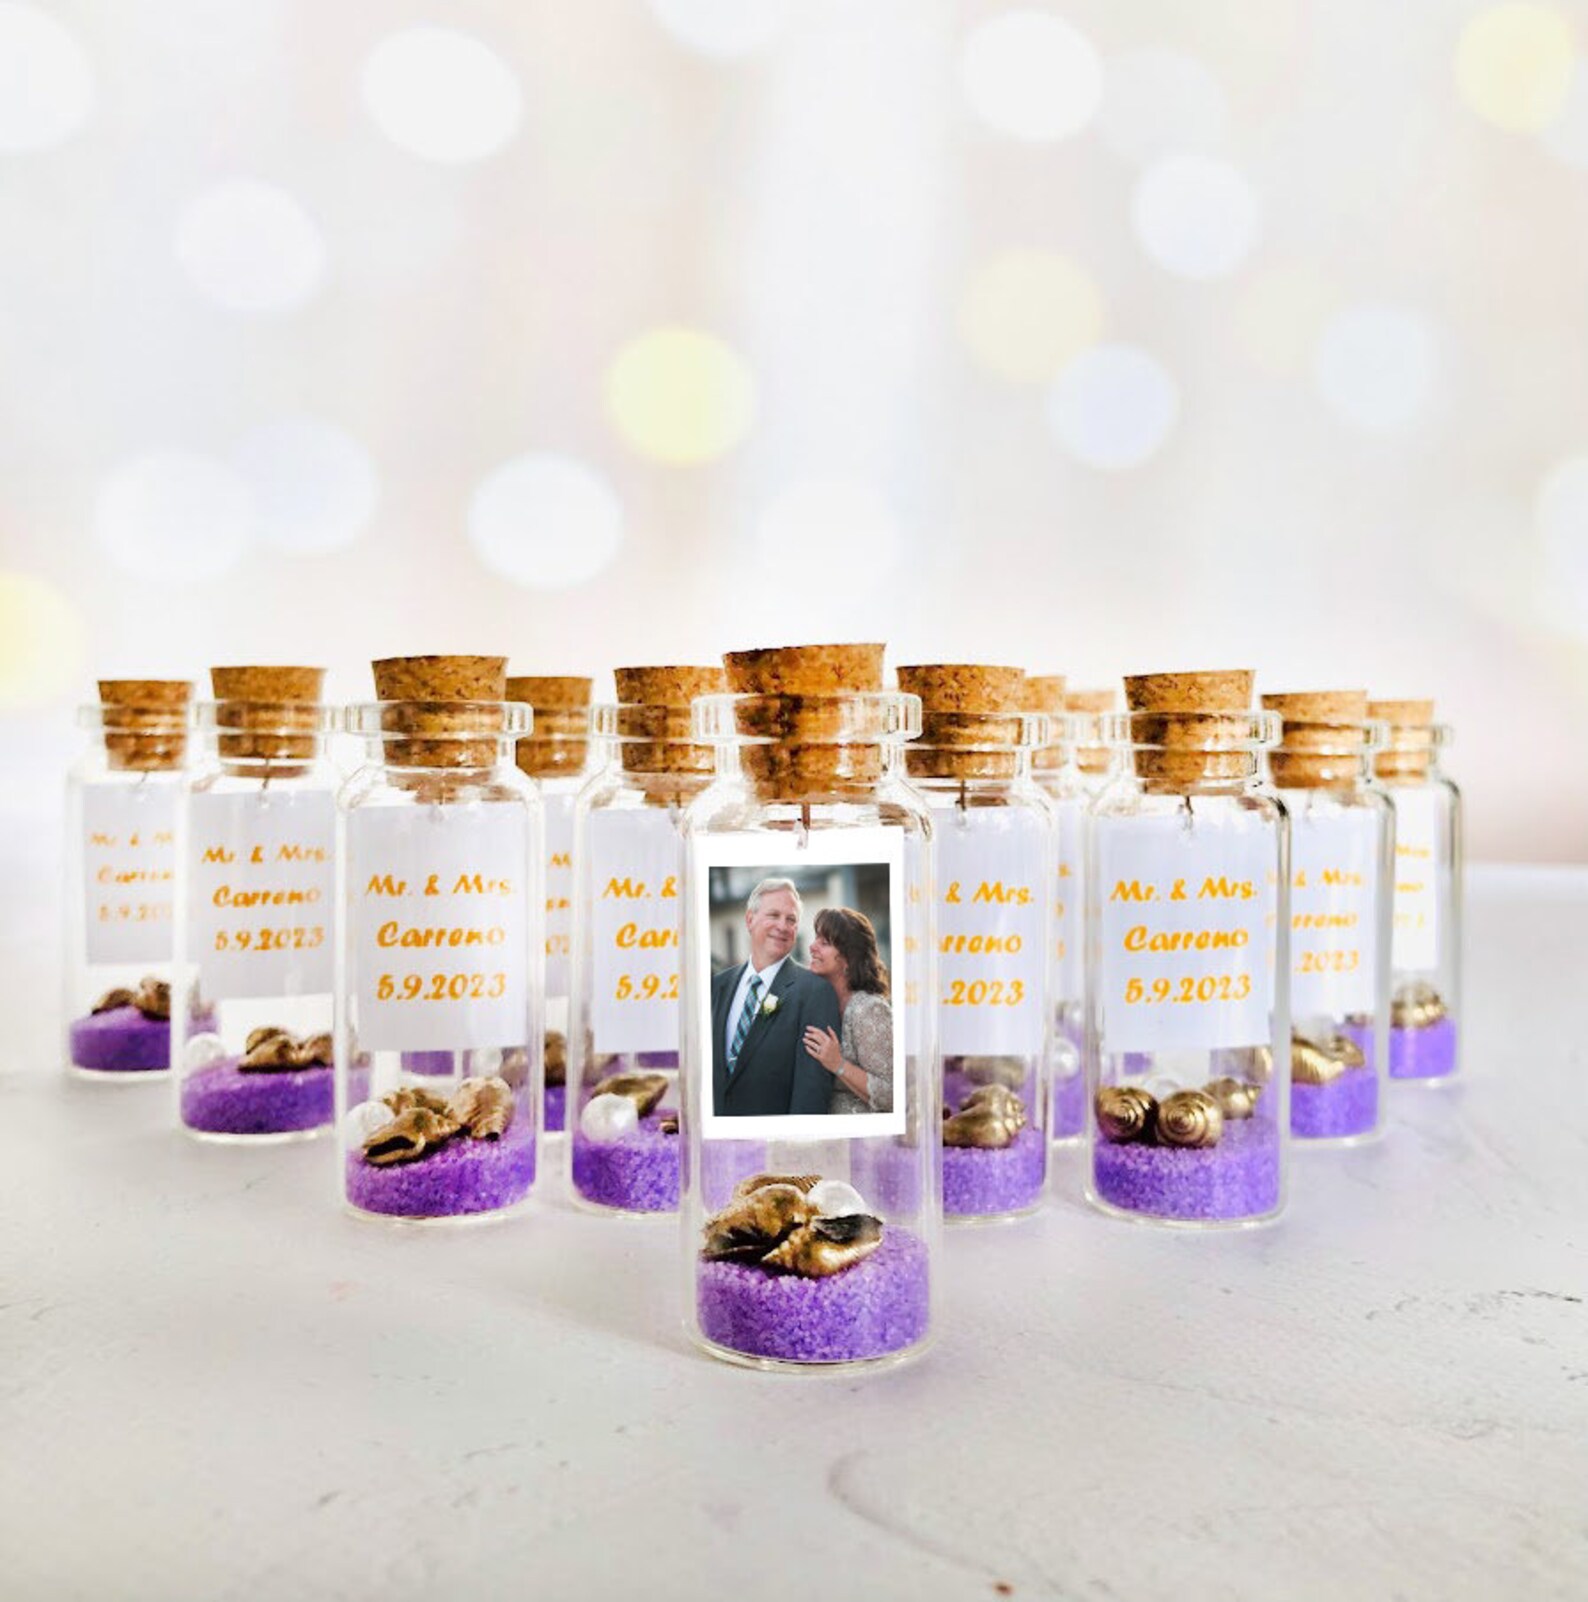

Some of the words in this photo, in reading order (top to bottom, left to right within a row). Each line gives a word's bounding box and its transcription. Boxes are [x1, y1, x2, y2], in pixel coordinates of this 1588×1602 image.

[250, 844, 264, 864] &
[212, 885, 320, 908] Carreno
[366, 873, 413, 897] Mr.
[424, 873, 440, 897] &
[453, 873, 515, 896] Mrs.
[602, 877, 652, 899] Mr.
[660, 876, 678, 898] &
[945, 880, 961, 903] &
[972, 880, 1035, 906] Mrs.
[1109, 880, 1161, 902] Mr.
[1170, 878, 1187, 900] &
[1197, 876, 1259, 900] Mrs.
[214, 926, 325, 951] 5.9.2023
[376, 920, 506, 948] Carreno
[939, 934, 1022, 955] rreno
[1123, 924, 1249, 953] Carreno
[376, 972, 507, 1001] 5.9.2023
[1125, 974, 1252, 1005] 5.9.2023
